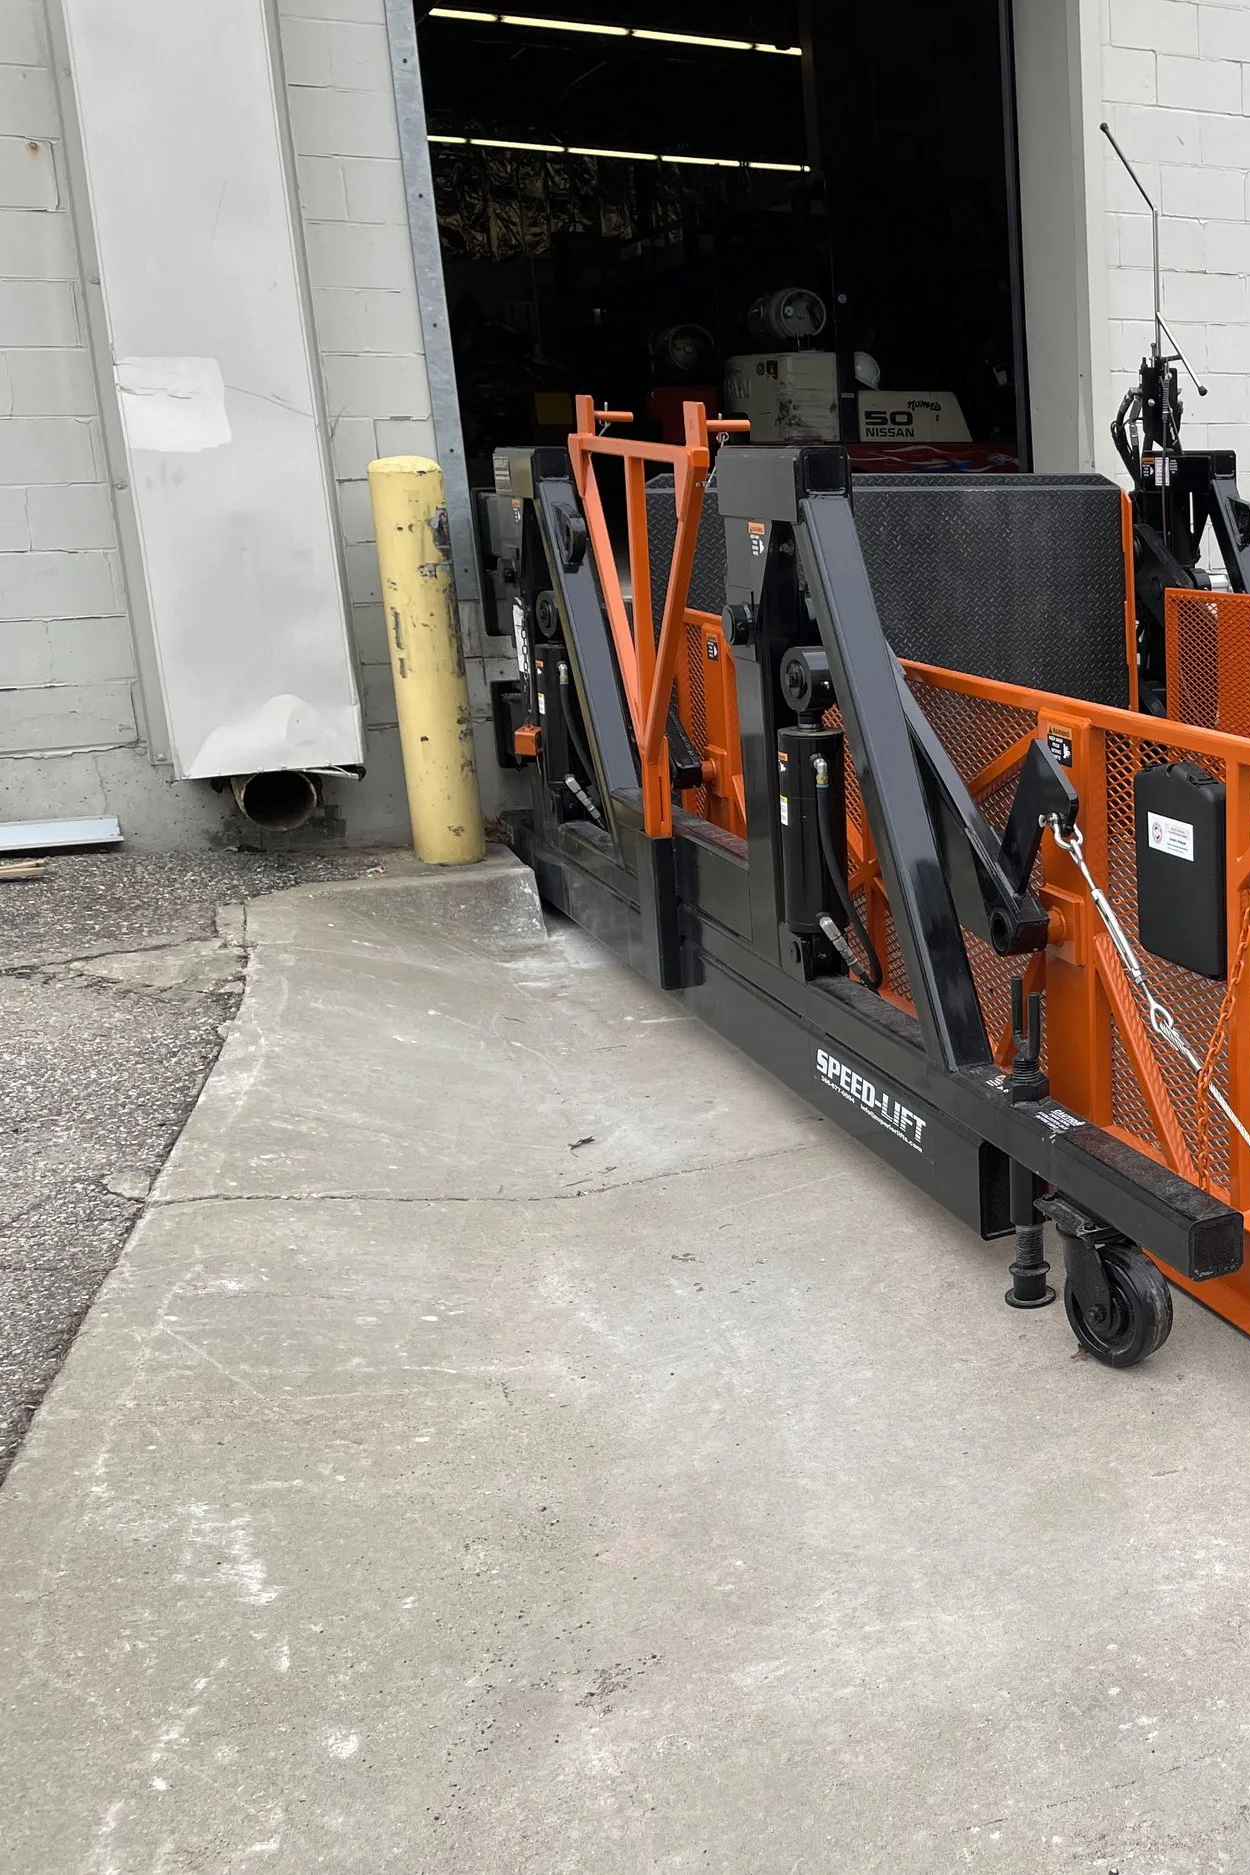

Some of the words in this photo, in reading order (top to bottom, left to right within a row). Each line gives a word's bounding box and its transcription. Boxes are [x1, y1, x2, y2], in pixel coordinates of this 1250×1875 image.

[865, 411, 913, 426] 50
[866, 428, 915, 438] NISSAN
[816, 1048, 927, 1144] SPEED-LIFT
